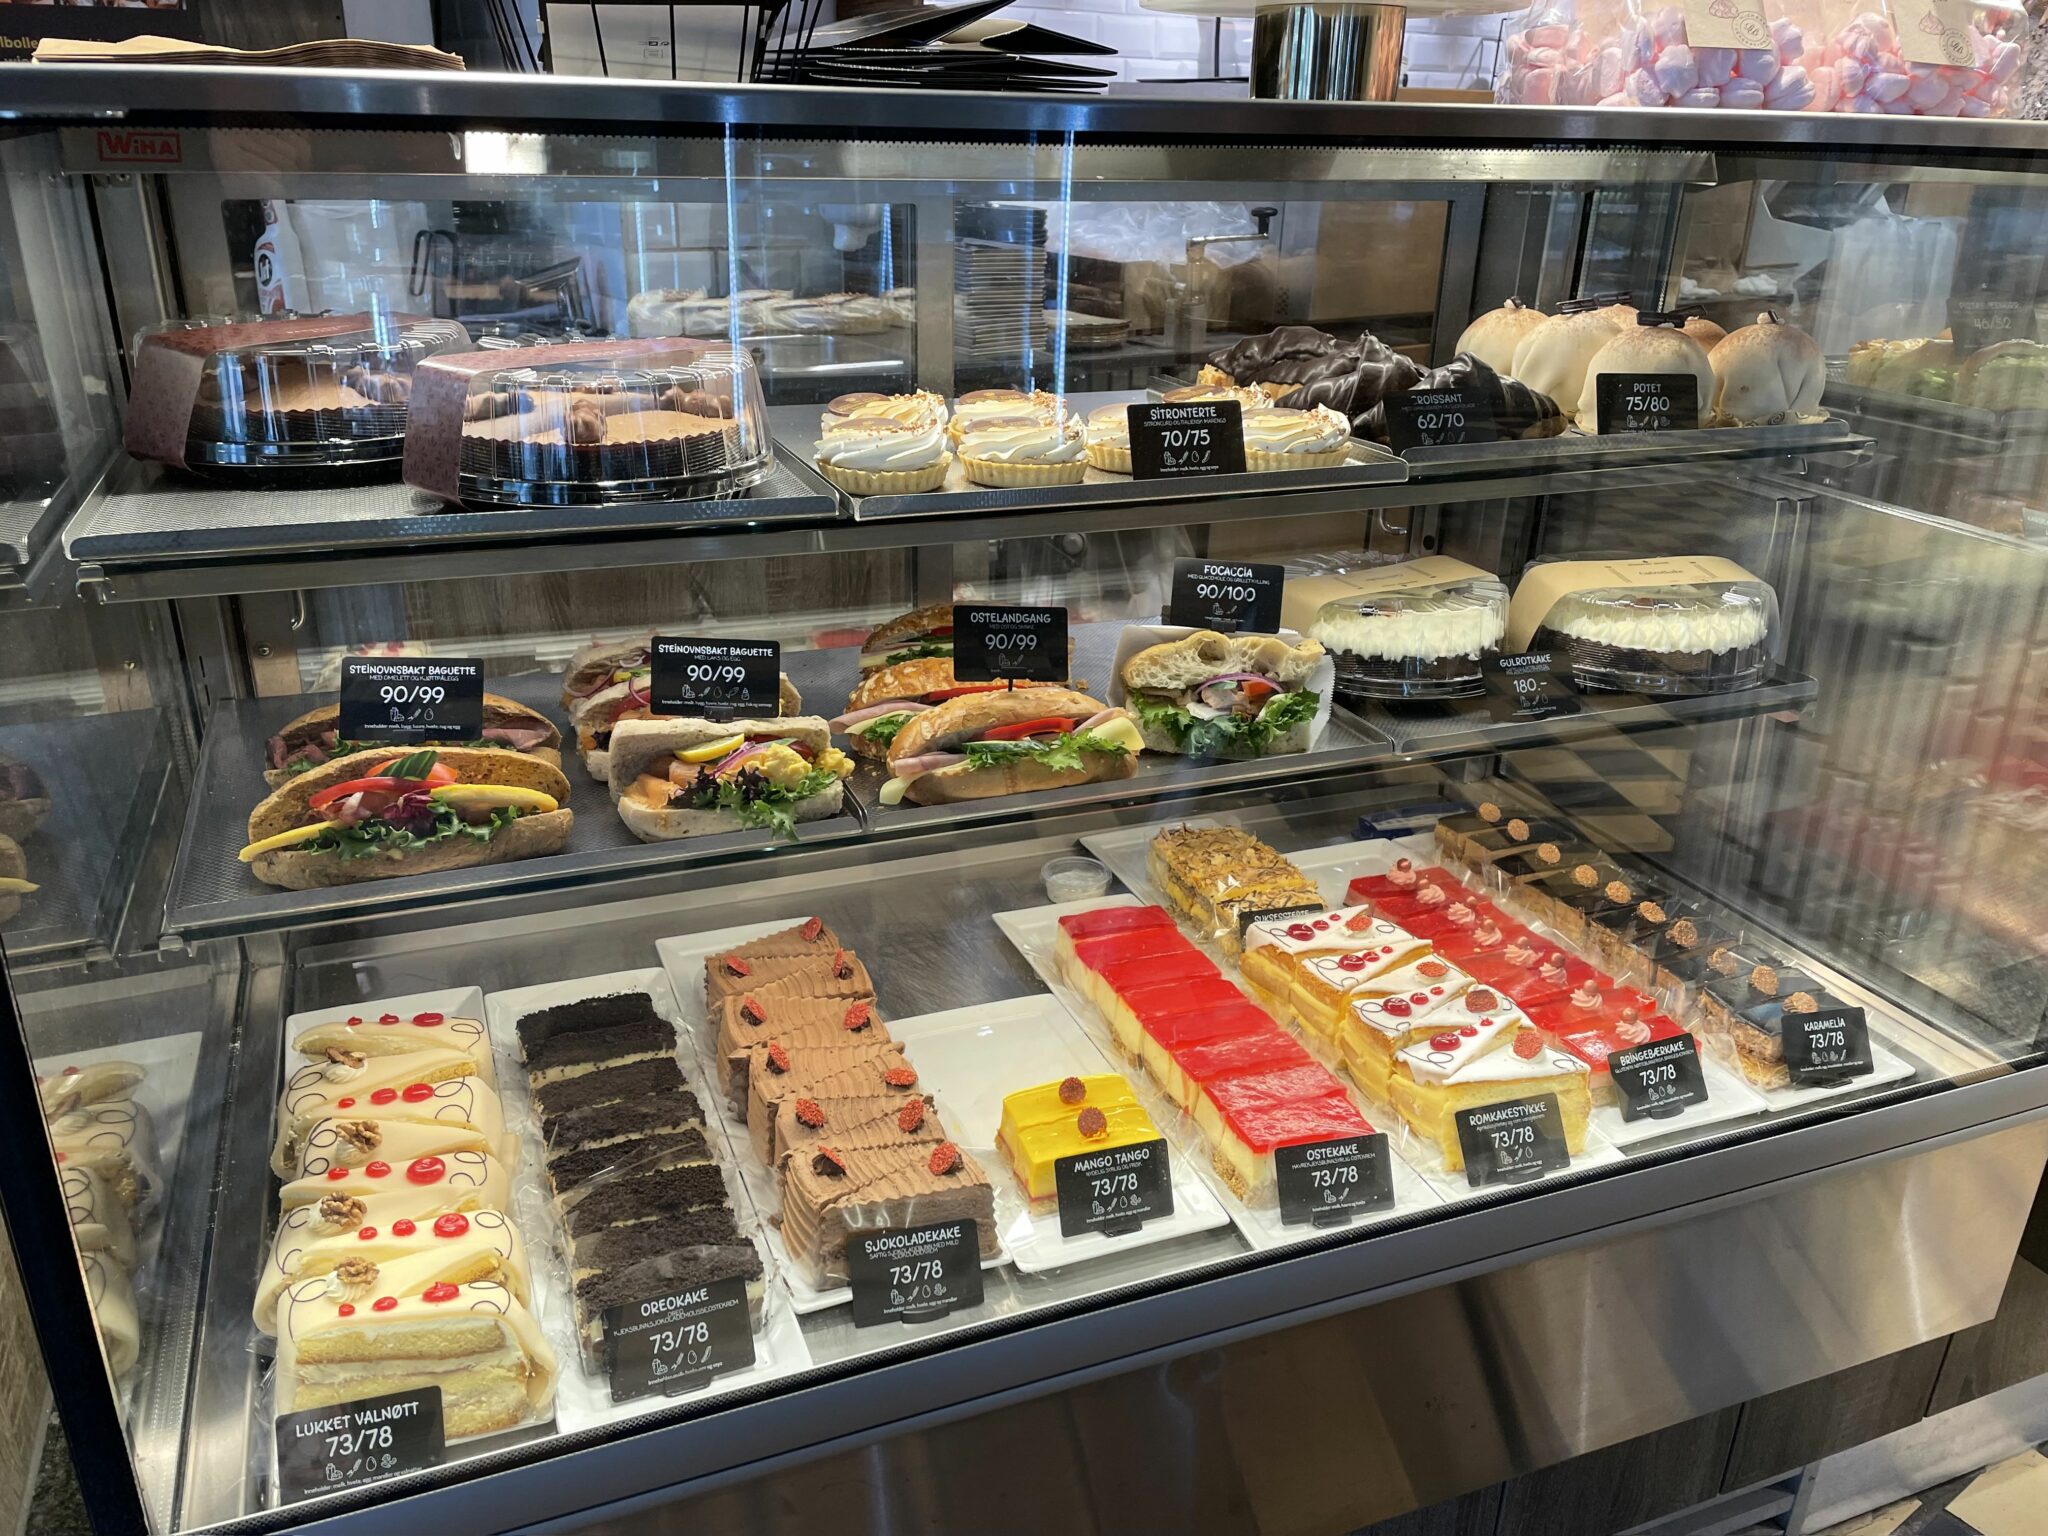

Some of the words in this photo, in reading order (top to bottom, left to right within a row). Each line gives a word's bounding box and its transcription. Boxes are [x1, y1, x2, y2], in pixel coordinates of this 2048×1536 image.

[1633, 383, 1662, 393] POTET
[1150, 406, 1217, 420] SITRONTERTE
[1625, 396, 1670, 412] 75/80
[1417, 412, 1465, 429] 62/70
[1161, 429, 1210, 448] 70/75
[1204, 564, 1254, 578] FOCACCIA
[1196, 583, 1256, 602] 90/100
[970, 612, 1052, 623] OSTELANDGANG
[658, 643, 728, 656] STEINOVNSBAKT
[730, 648, 774, 657] BAGUETTE
[985, 633, 1038, 650] 90/99
[349, 663, 426, 675] STEINOVNSBAKT
[428, 666, 477, 675] BAGUETTE
[1499, 653, 1552, 668] GULROTKAKE
[687, 664, 746, 683] 90/99
[380, 685, 445, 704] 90/99
[1513, 678, 1548, 693] 180.-
[1803, 1016, 1846, 1032] KARAMELIA
[1808, 1030, 1845, 1049] 73/78
[1619, 1041, 1685, 1066] BRINGEBÆRKAKE
[1639, 1063, 1677, 1087] 73/78
[1469, 1101, 1548, 1127] ROMKAKESTYKKE
[1490, 1126, 1535, 1149] 73/78
[1073, 1155, 1113, 1173] MANGO
[1115, 1148, 1150, 1164] TANGO
[1306, 1143, 1359, 1161] OSTEKAKE
[1091, 1172, 1138, 1198] 73/78
[1311, 1165, 1359, 1188] 73/78
[864, 1225, 962, 1253] SJOKOLADEKAKE
[889, 1258, 943, 1286] 73/78
[640, 1287, 709, 1317] OREOKAKE
[649, 1321, 710, 1355] 73/78
[295, 1414, 351, 1438] LUKKET
[354, 1401, 420, 1426] VALNØTT
[325, 1425, 393, 1459] 73/78
